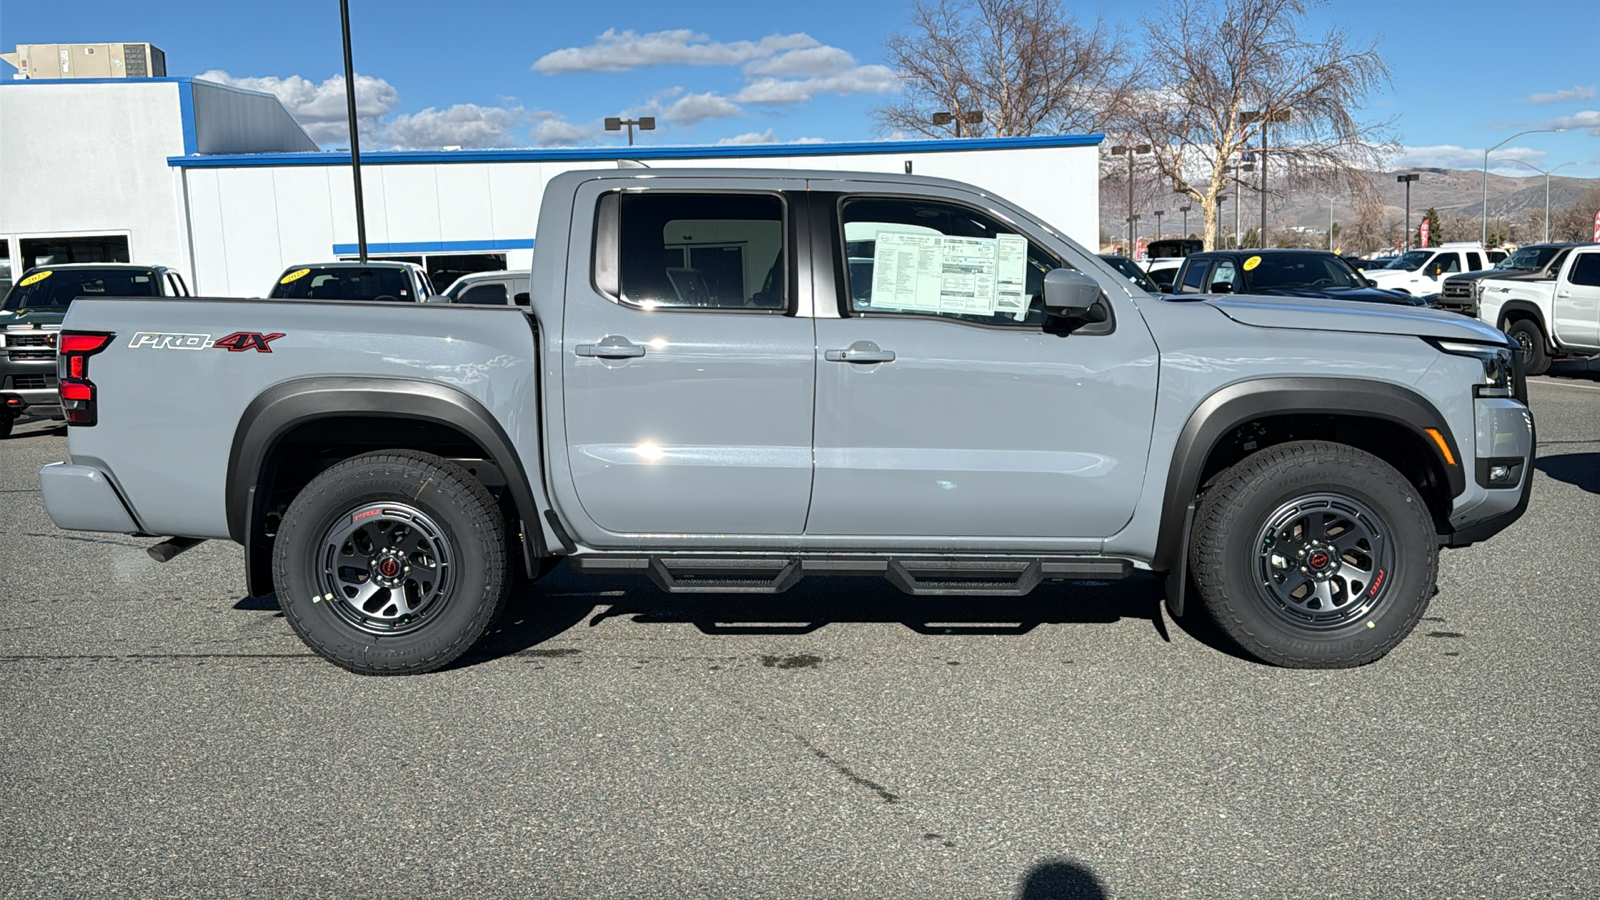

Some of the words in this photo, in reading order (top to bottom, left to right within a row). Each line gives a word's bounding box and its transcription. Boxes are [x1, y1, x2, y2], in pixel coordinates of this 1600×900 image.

[28, 272, 46, 283] 2025
[288, 270, 305, 280] 2025
[354, 509, 380, 522] PRO
[1370, 569, 1384, 596] PRO
